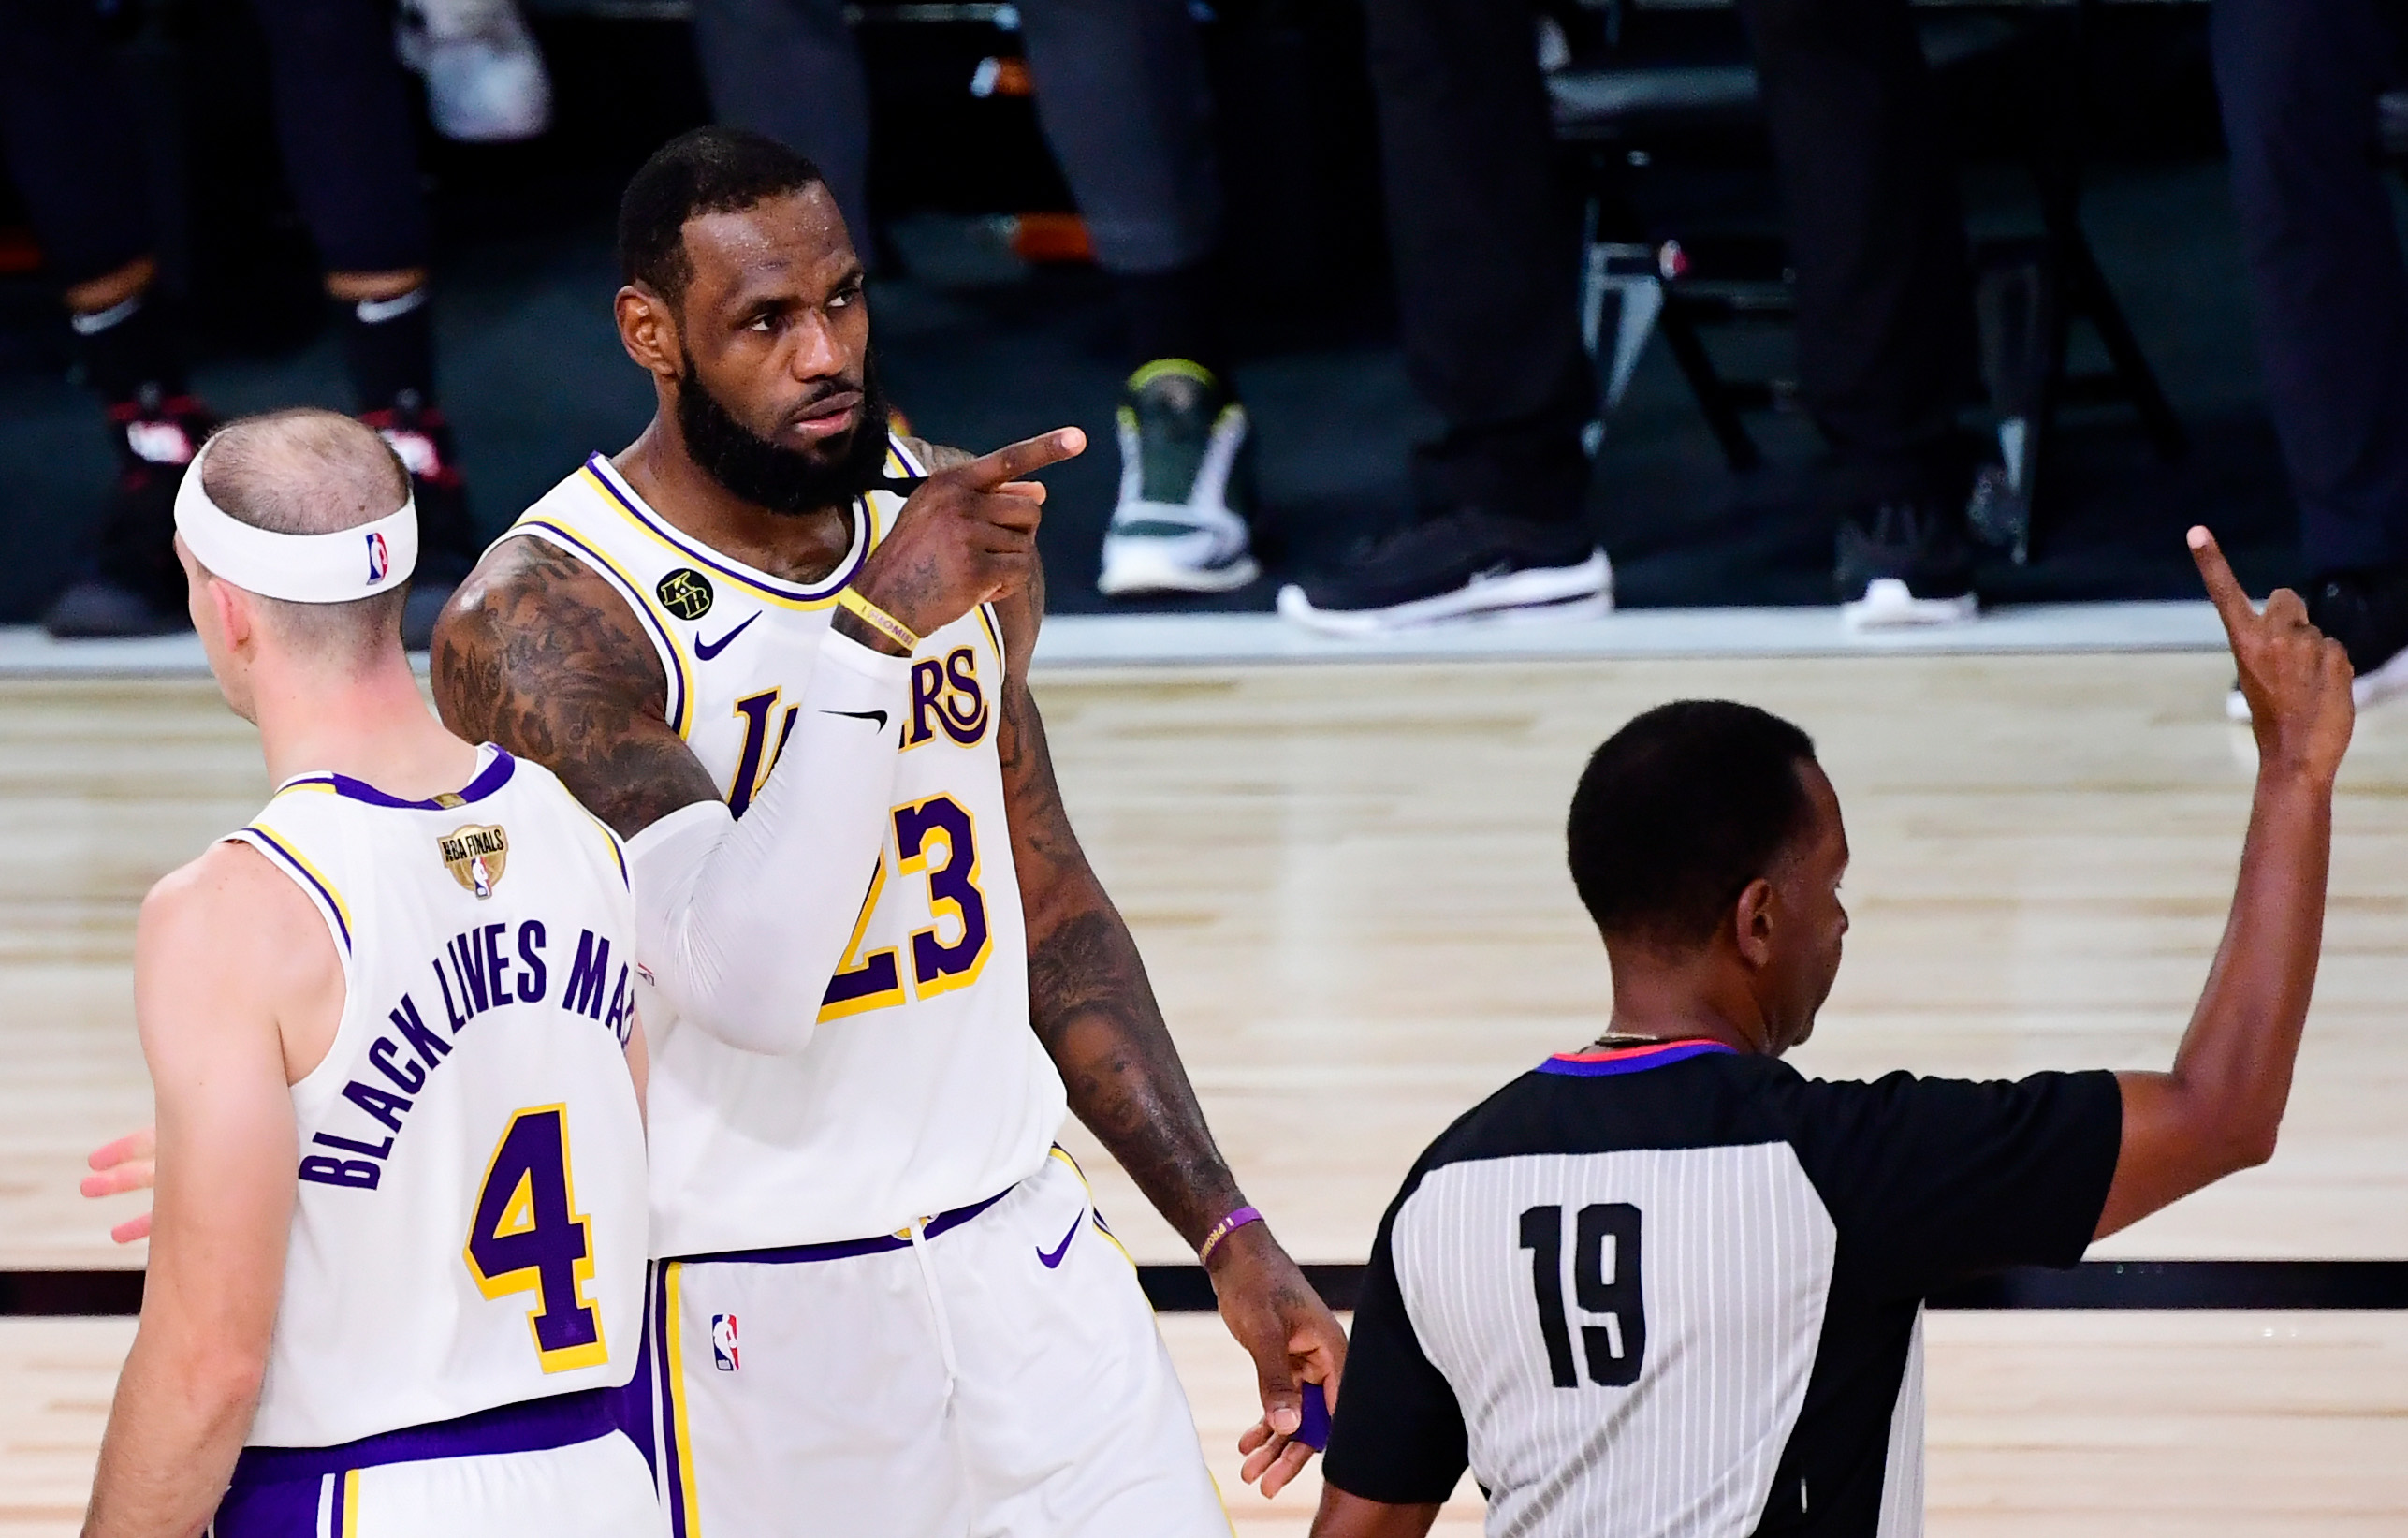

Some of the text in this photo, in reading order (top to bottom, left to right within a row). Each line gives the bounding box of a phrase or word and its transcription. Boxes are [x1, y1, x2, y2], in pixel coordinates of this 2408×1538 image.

[661, 570, 710, 619] KB
[442, 828, 505, 862] NBA FINALS
[299, 992, 454, 1191] BLACK
[431, 919, 547, 1035] LIVES
[462, 1102, 609, 1375] 4
[1520, 1203, 1646, 1388] 19
